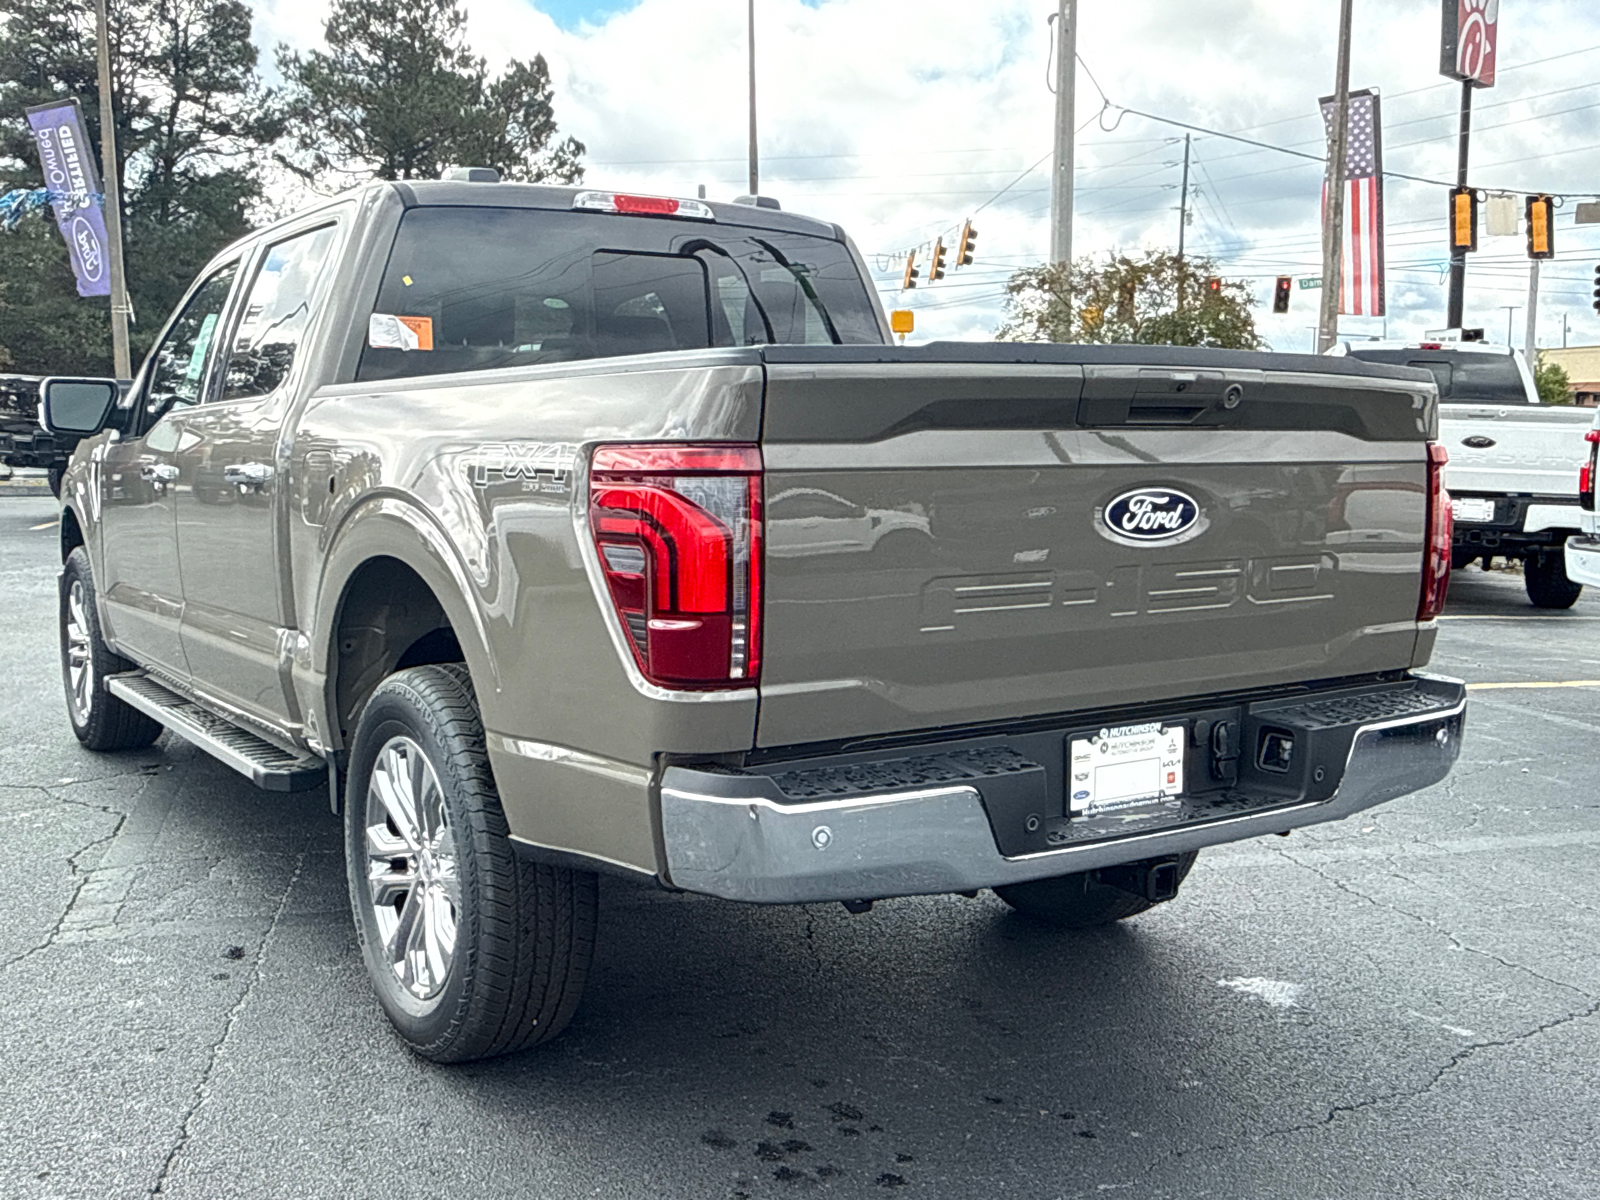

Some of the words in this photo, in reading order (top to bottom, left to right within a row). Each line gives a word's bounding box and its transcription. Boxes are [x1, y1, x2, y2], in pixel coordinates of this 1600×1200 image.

[474, 441, 567, 489] FX4
[1122, 495, 1184, 531] Ford
[1109, 722, 1162, 738] HUTCHINSON
